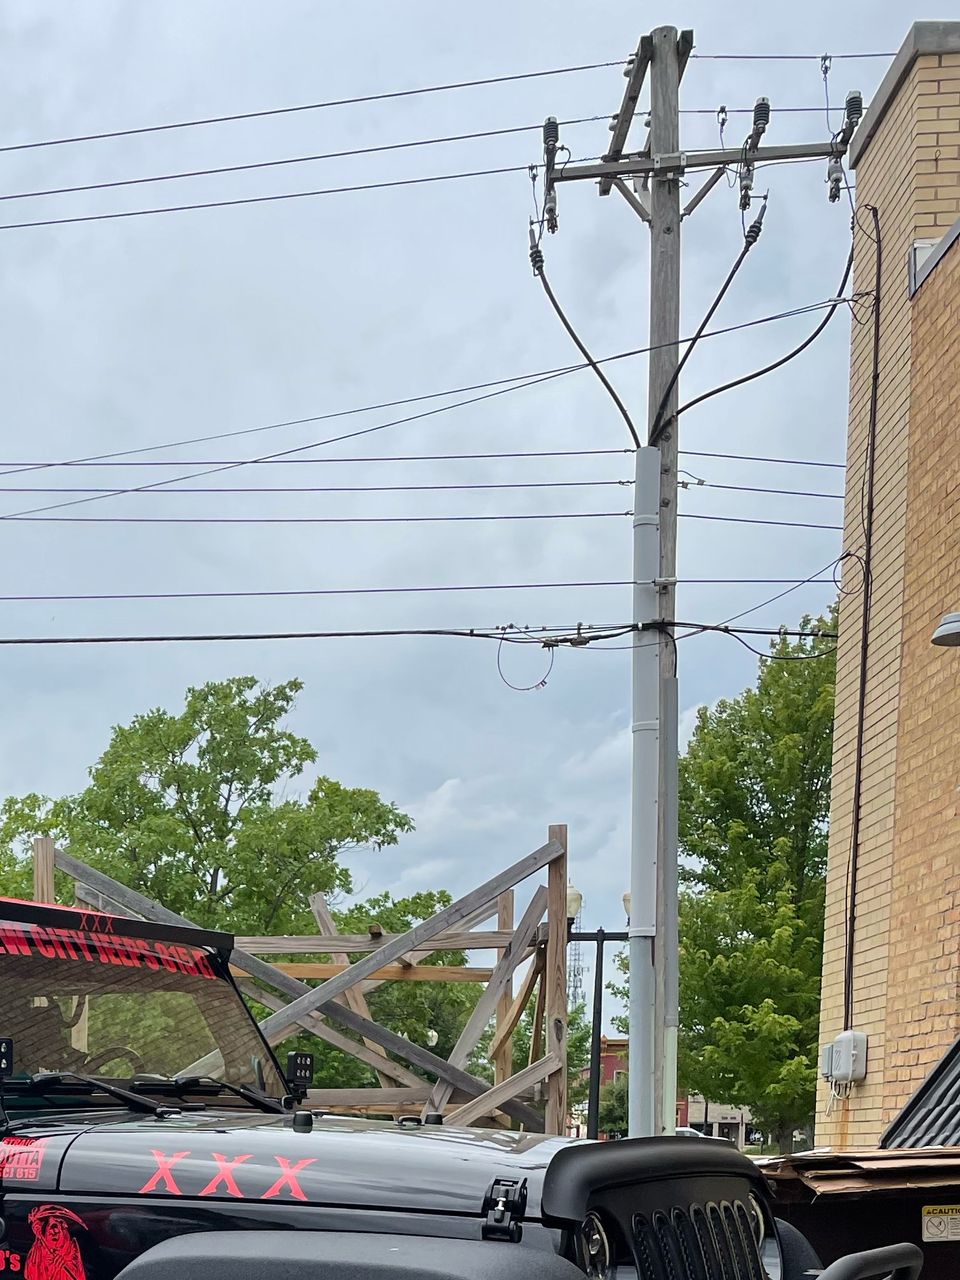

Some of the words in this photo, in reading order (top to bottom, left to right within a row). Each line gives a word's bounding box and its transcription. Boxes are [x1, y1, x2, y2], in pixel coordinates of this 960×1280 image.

[79, 913, 114, 933] XXX
[30, 926, 93, 962] CITY
[89, 932, 160, 971] JEEPS
